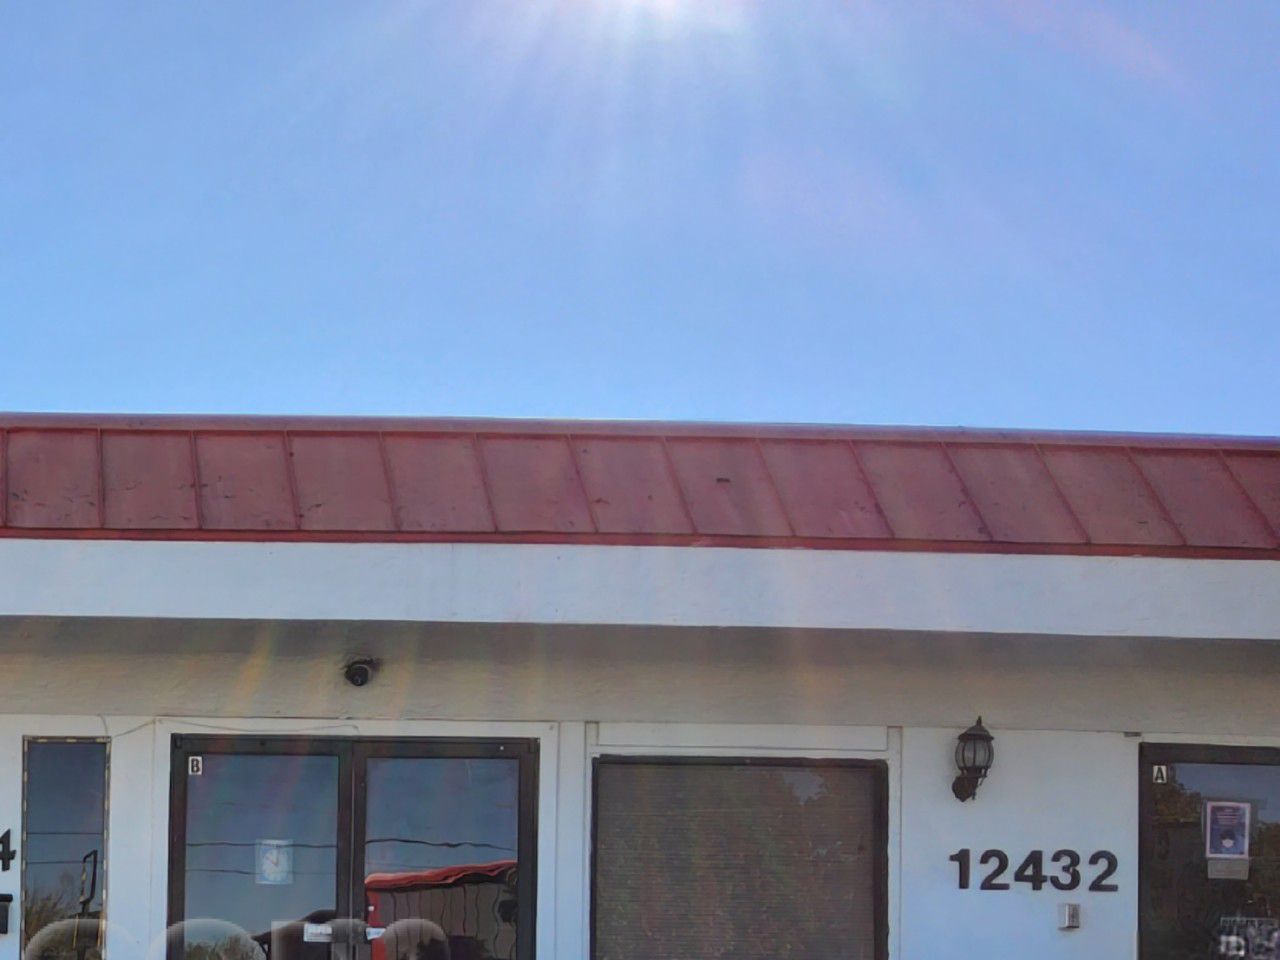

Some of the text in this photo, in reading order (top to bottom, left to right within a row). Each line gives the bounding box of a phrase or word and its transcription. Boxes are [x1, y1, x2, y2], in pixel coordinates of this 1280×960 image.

[190, 757, 201, 774] B
[1154, 766, 1166, 782] A
[949, 848, 1119, 892] 12432
